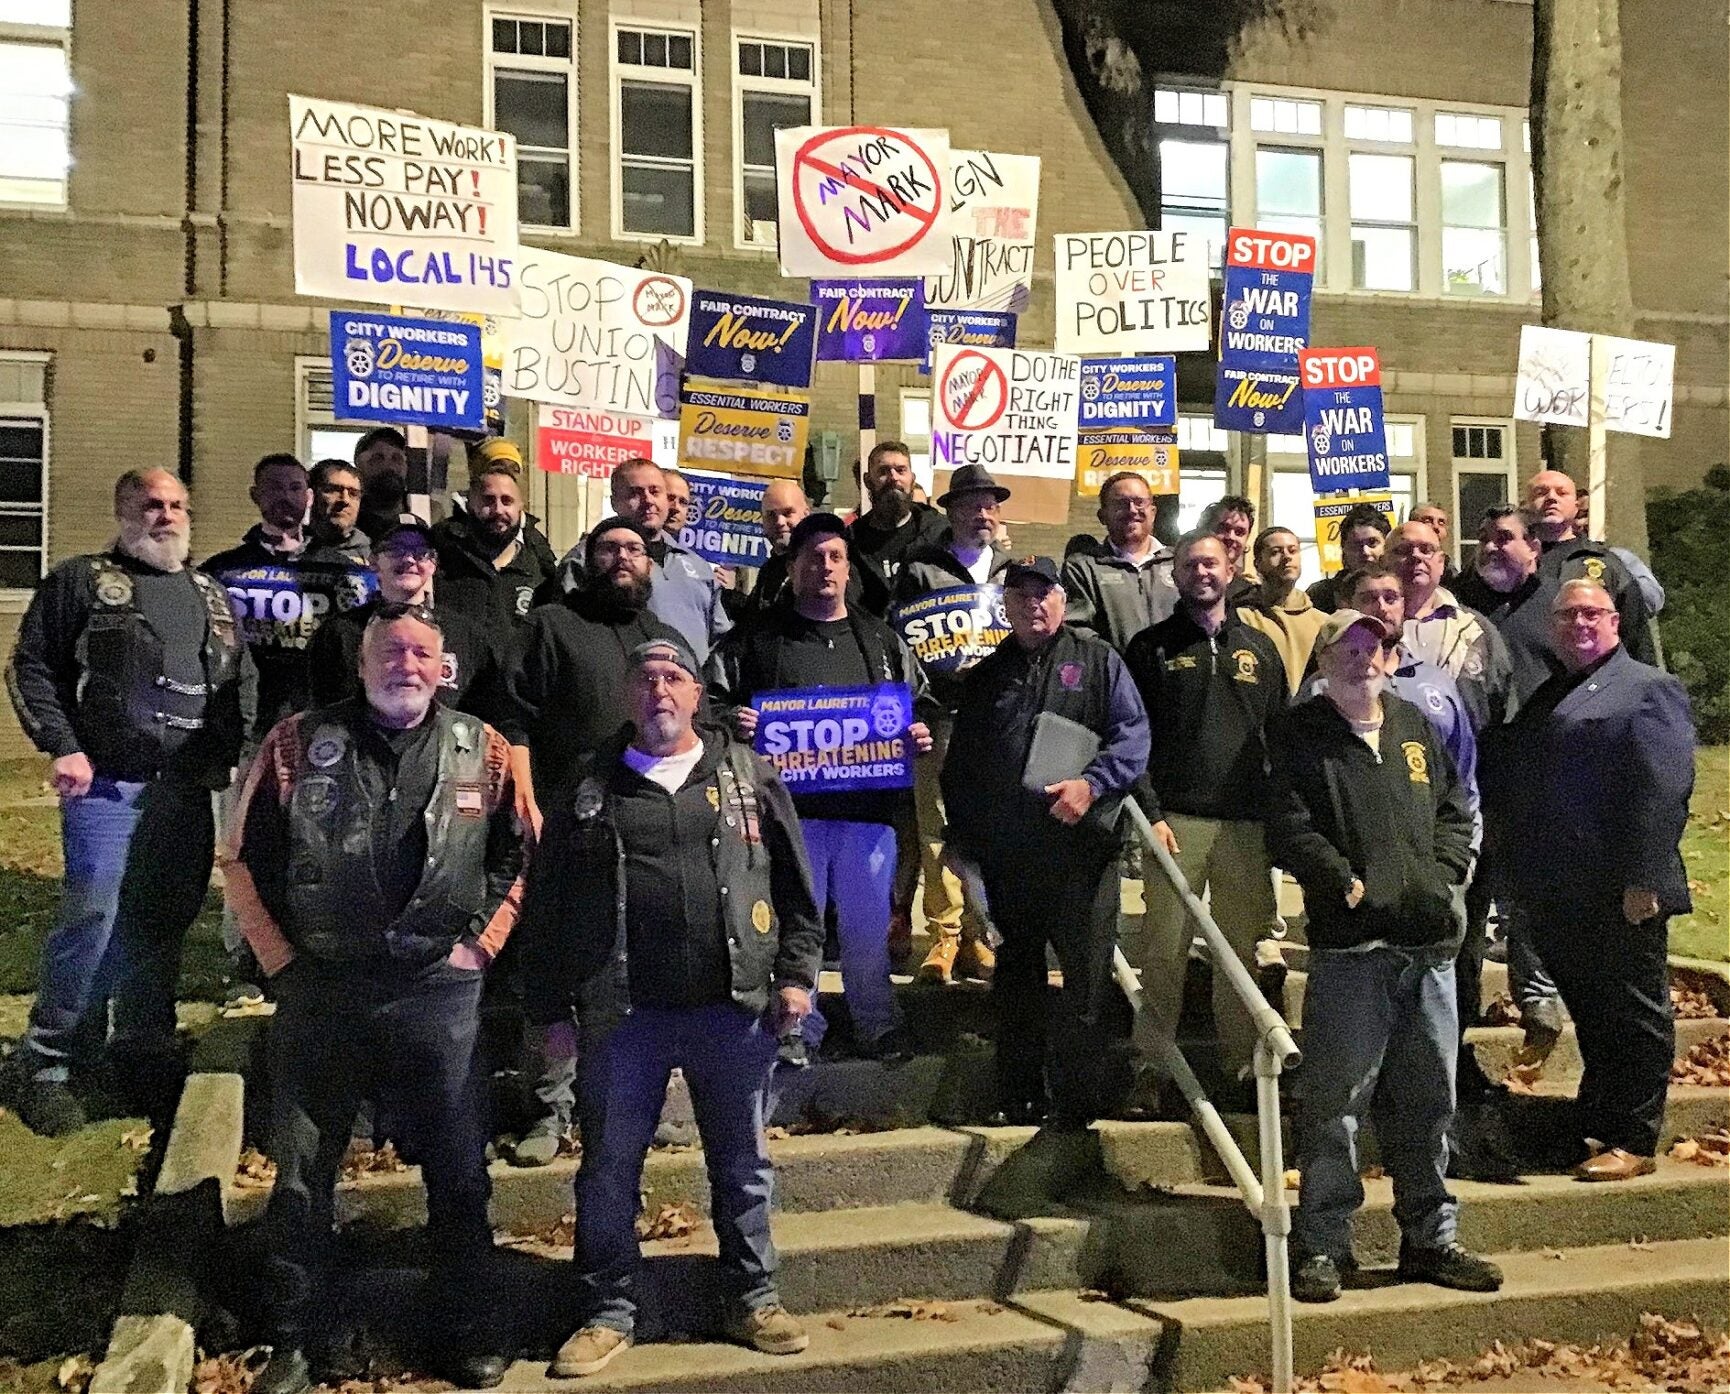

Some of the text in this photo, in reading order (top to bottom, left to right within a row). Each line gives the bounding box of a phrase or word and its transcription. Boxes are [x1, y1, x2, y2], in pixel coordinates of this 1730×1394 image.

[295, 108, 507, 165] MORE WORK!
[295, 148, 482, 198] LESS PAY!
[819, 136, 900, 205] MAYOR
[843, 165, 932, 244] MARK
[1066, 232, 1188, 270] PEOPLE
[1233, 235, 1312, 268] STOP
[346, 243, 513, 289] LOCAL 145
[520, 263, 625, 321] STOP
[1089, 269, 1166, 296] OVER
[1261, 272, 1280, 287] THE
[818, 287, 916, 299] FAIR CONTRACT
[1243, 287, 1300, 318] WAR
[700, 299, 807, 324] FAIR CONTRACT
[826, 294, 911, 334] Now!
[931, 313, 956, 323] CITY
[1076, 296, 1209, 337] POLITICS
[1259, 318, 1275, 331] ON
[344, 320, 468, 347] CITY WORKERS
[703, 311, 801, 354] Now!
[1227, 331, 1306, 355] WORKERS
[376, 337, 470, 375] Deserve
[1082, 362, 1165, 374] CITY WORKERS
[378, 371, 393, 381] TO
[437, 376, 467, 387] WITH
[1101, 372, 1165, 393] Deserve
[1223, 369, 1301, 385] FAIR CONTRACT
[1305, 355, 1375, 385] STOP
[348, 380, 470, 416] DIGNITY
[689, 392, 803, 416] ESSENTIAL WORKERS
[1010, 386, 1073, 412] RIGHT
[1102, 392, 1112, 400] TO
[1143, 391, 1163, 400] WITH
[1227, 376, 1297, 411] Now!
[1334, 391, 1352, 404] THE
[552, 409, 642, 436] STAND UP
[1005, 413, 1059, 430] THING
[1082, 400, 1166, 420] DIGNITY
[1320, 406, 1374, 436] WAR
[693, 411, 771, 439] Deserve
[686, 436, 797, 467] RESPECT
[932, 429, 1072, 466] NEGOTIATE
[1083, 434, 1173, 445] ESSENTIAL WORKERS
[1341, 439, 1354, 452] ON
[560, 458, 615, 478] RIGHT
[1090, 448, 1151, 468] Deserve
[1314, 453, 1386, 476] WORKERS
[1083, 469, 1173, 488] RECT
[718, 485, 764, 502] WORK
[705, 495, 763, 523] Deser
[1319, 504, 1353, 517] ESSENTIA
[679, 527, 773, 559] DIGNITY
[227, 586, 330, 623] STOP
[899, 598, 936, 618] MAYOR
[904, 608, 993, 646] STOP
[923, 646, 958, 663] CITY
[760, 699, 806, 713] MAYOR
[764, 718, 869, 756] STOP
[780, 763, 905, 783] CITY WORKERS
